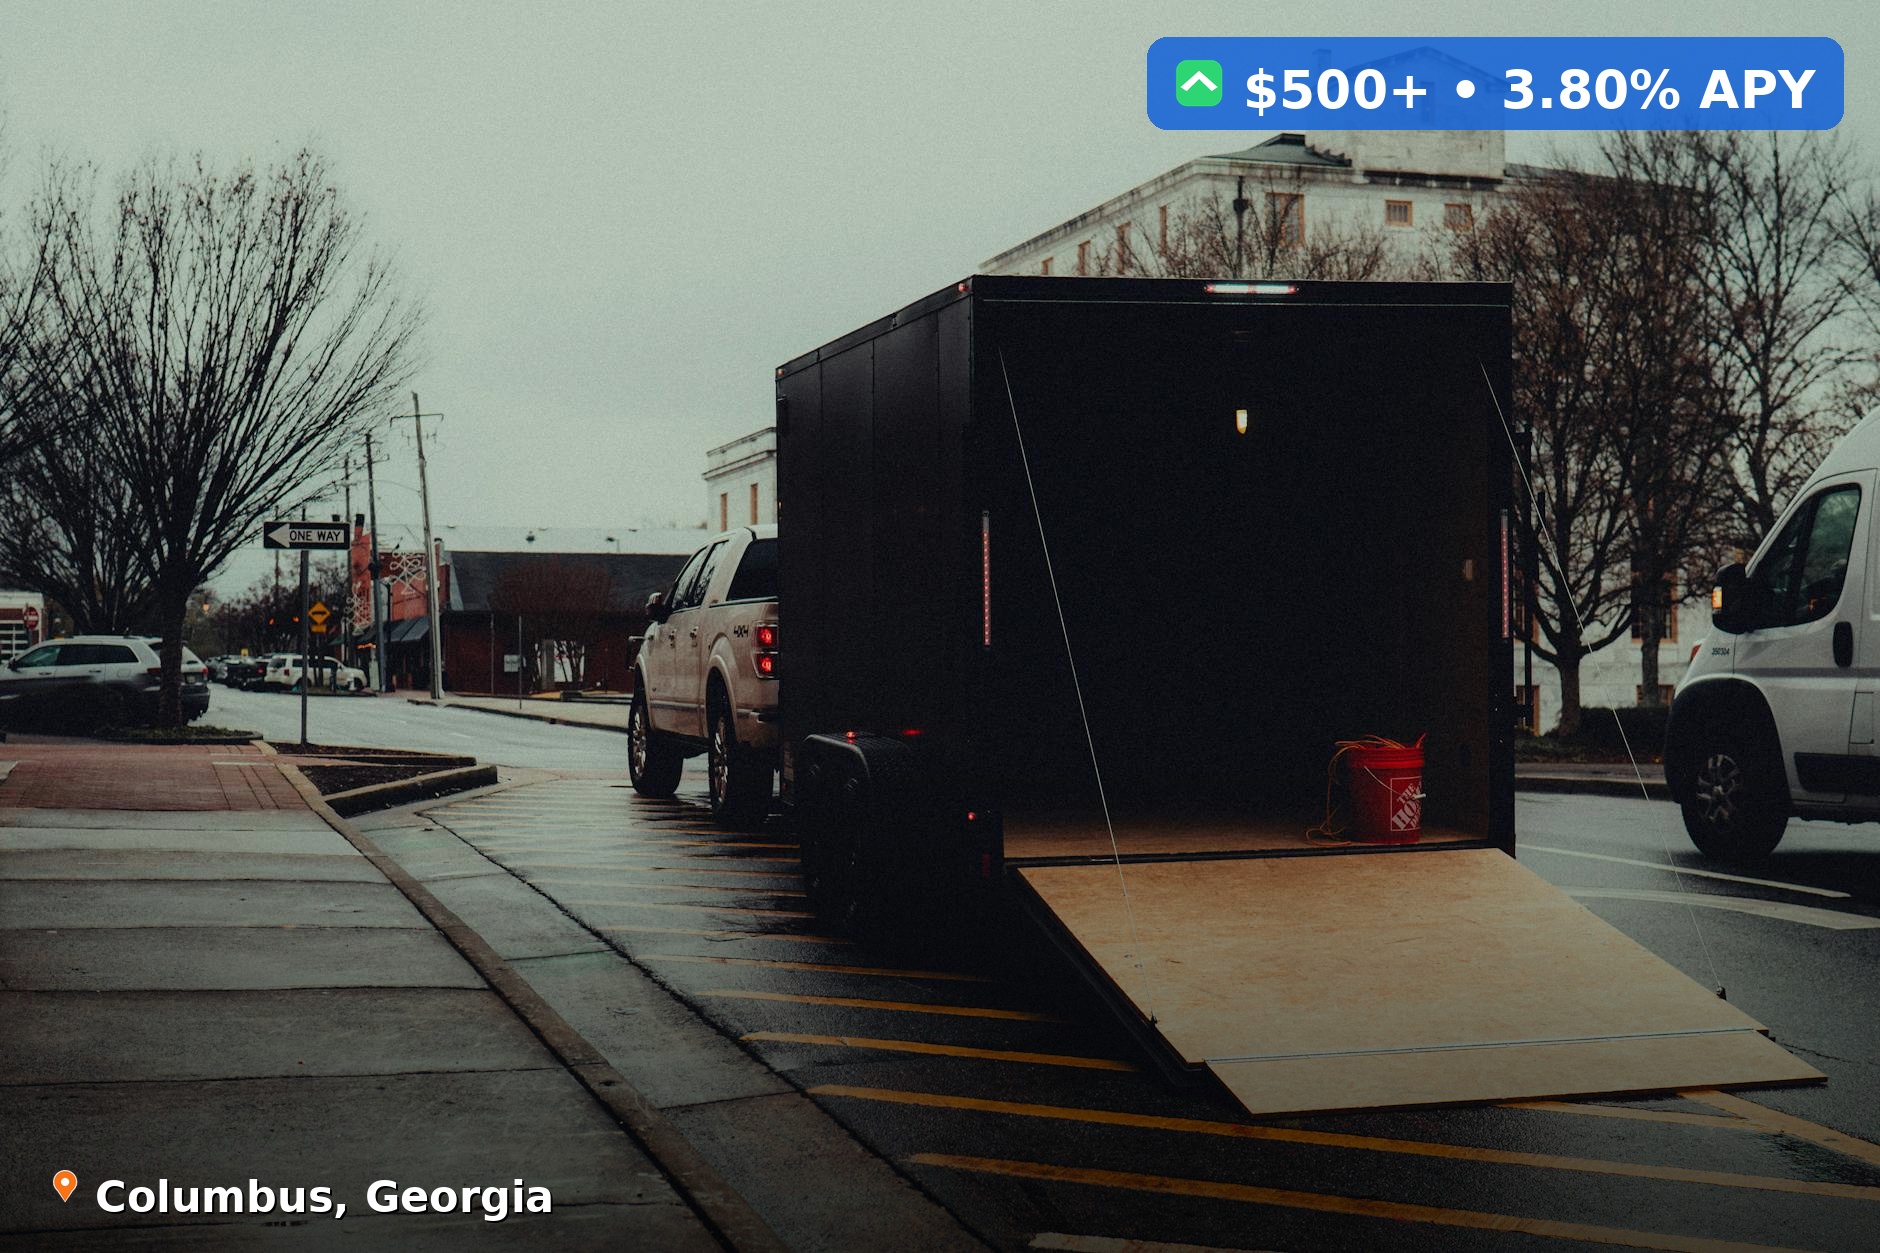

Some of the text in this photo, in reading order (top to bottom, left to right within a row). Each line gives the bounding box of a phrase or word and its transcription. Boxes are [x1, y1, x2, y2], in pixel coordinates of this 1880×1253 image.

[289, 530, 341, 541] ONE WAY
[1396, 783, 1416, 804] THE
